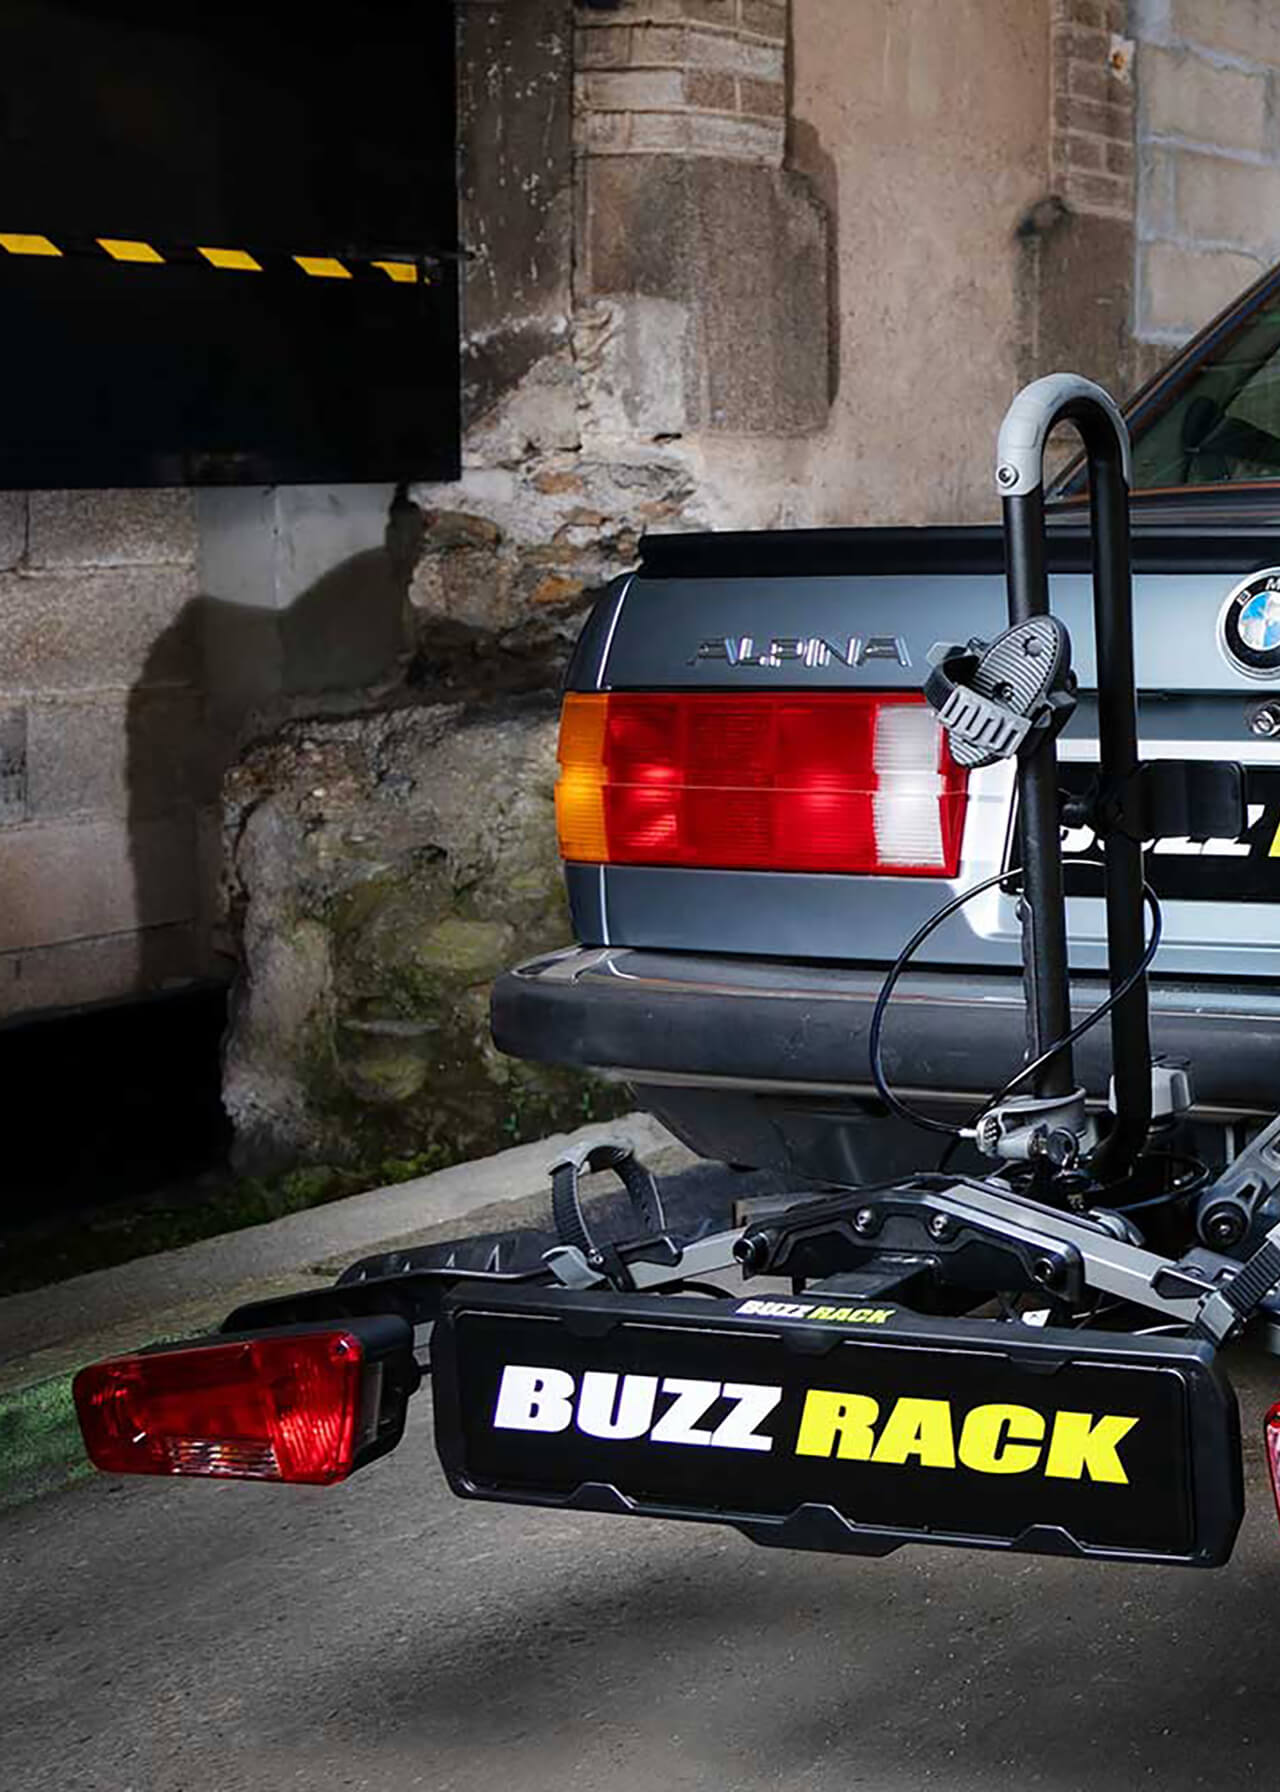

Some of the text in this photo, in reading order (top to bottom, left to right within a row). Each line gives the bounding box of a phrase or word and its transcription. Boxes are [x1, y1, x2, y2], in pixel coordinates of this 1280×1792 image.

[686, 635, 913, 668] ALPINA
[735, 1300, 896, 1324] BUZZ RACK
[493, 1364, 1141, 1484] BUZZ RACK
